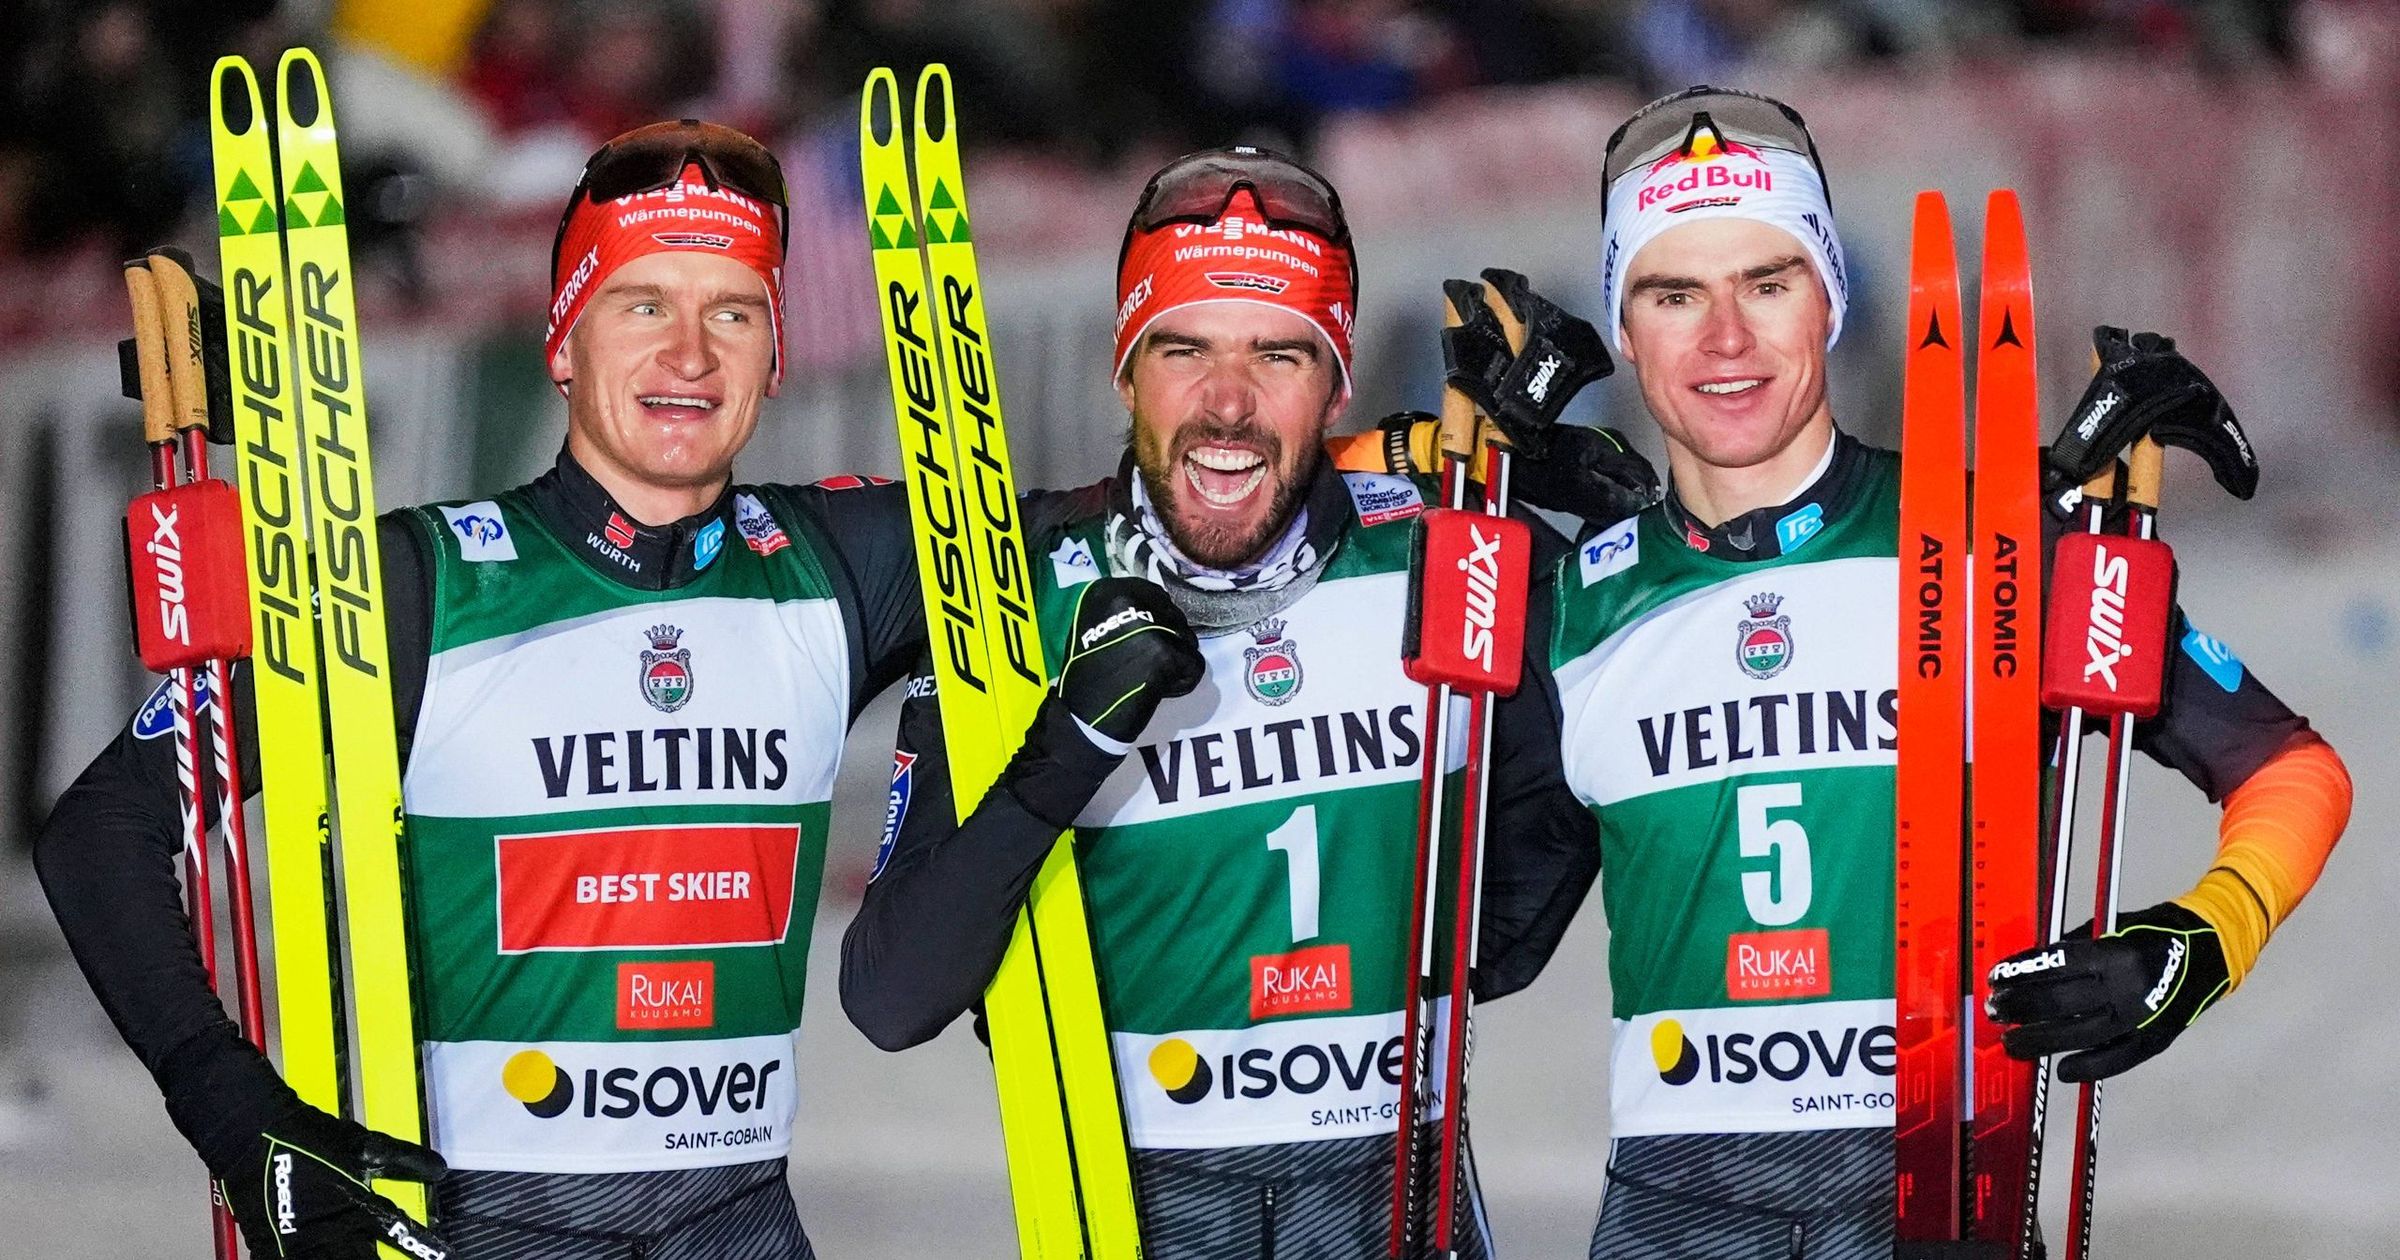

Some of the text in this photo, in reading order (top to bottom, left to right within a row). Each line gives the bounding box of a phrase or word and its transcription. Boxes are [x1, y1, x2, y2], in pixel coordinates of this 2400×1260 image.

[1638, 166, 1772, 212] Red Bull
[617, 207, 762, 237] Wärmepumpen
[551, 244, 601, 323] TERREX
[1175, 244, 1319, 278] Wärmepumpen
[233, 267, 305, 684] FISCHER
[300, 260, 378, 678] FISCHER
[889, 280, 987, 694] FISCHER
[943, 274, 1041, 688] FISCHER
[586, 532, 642, 574] WÜRTH
[1081, 606, 1154, 650] Roeckl
[1919, 533, 1943, 679] ATOMIC
[1993, 532, 2018, 679] ATOMIC
[531, 728, 789, 799] VELTINS
[1137, 705, 1421, 805] VELTINS
[1637, 689, 1898, 778] VELTINS
[1266, 804, 1320, 944] 1
[1737, 782, 1812, 926] 5
[576, 870, 751, 904] BEST SKIER
[630, 973, 703, 1007] RUKA!
[1264, 963, 1337, 994] RUKA!
[1738, 944, 1815, 977] RUKA!
[1740, 976, 1817, 988] KUUSAMO
[1993, 949, 2067, 980] Roeckl
[2144, 937, 2186, 1012] Roeckl
[630, 1007, 703, 1019] KUUSAMO
[1706, 1025, 1897, 1085] isove
[1792, 1093, 1896, 1115] SAINT-GO
[665, 1125, 772, 1150] SAINT-GOBAIN
[273, 1152, 298, 1235] Roeckl
[2022, 1146, 2039, 1260] AERODYNAMI
